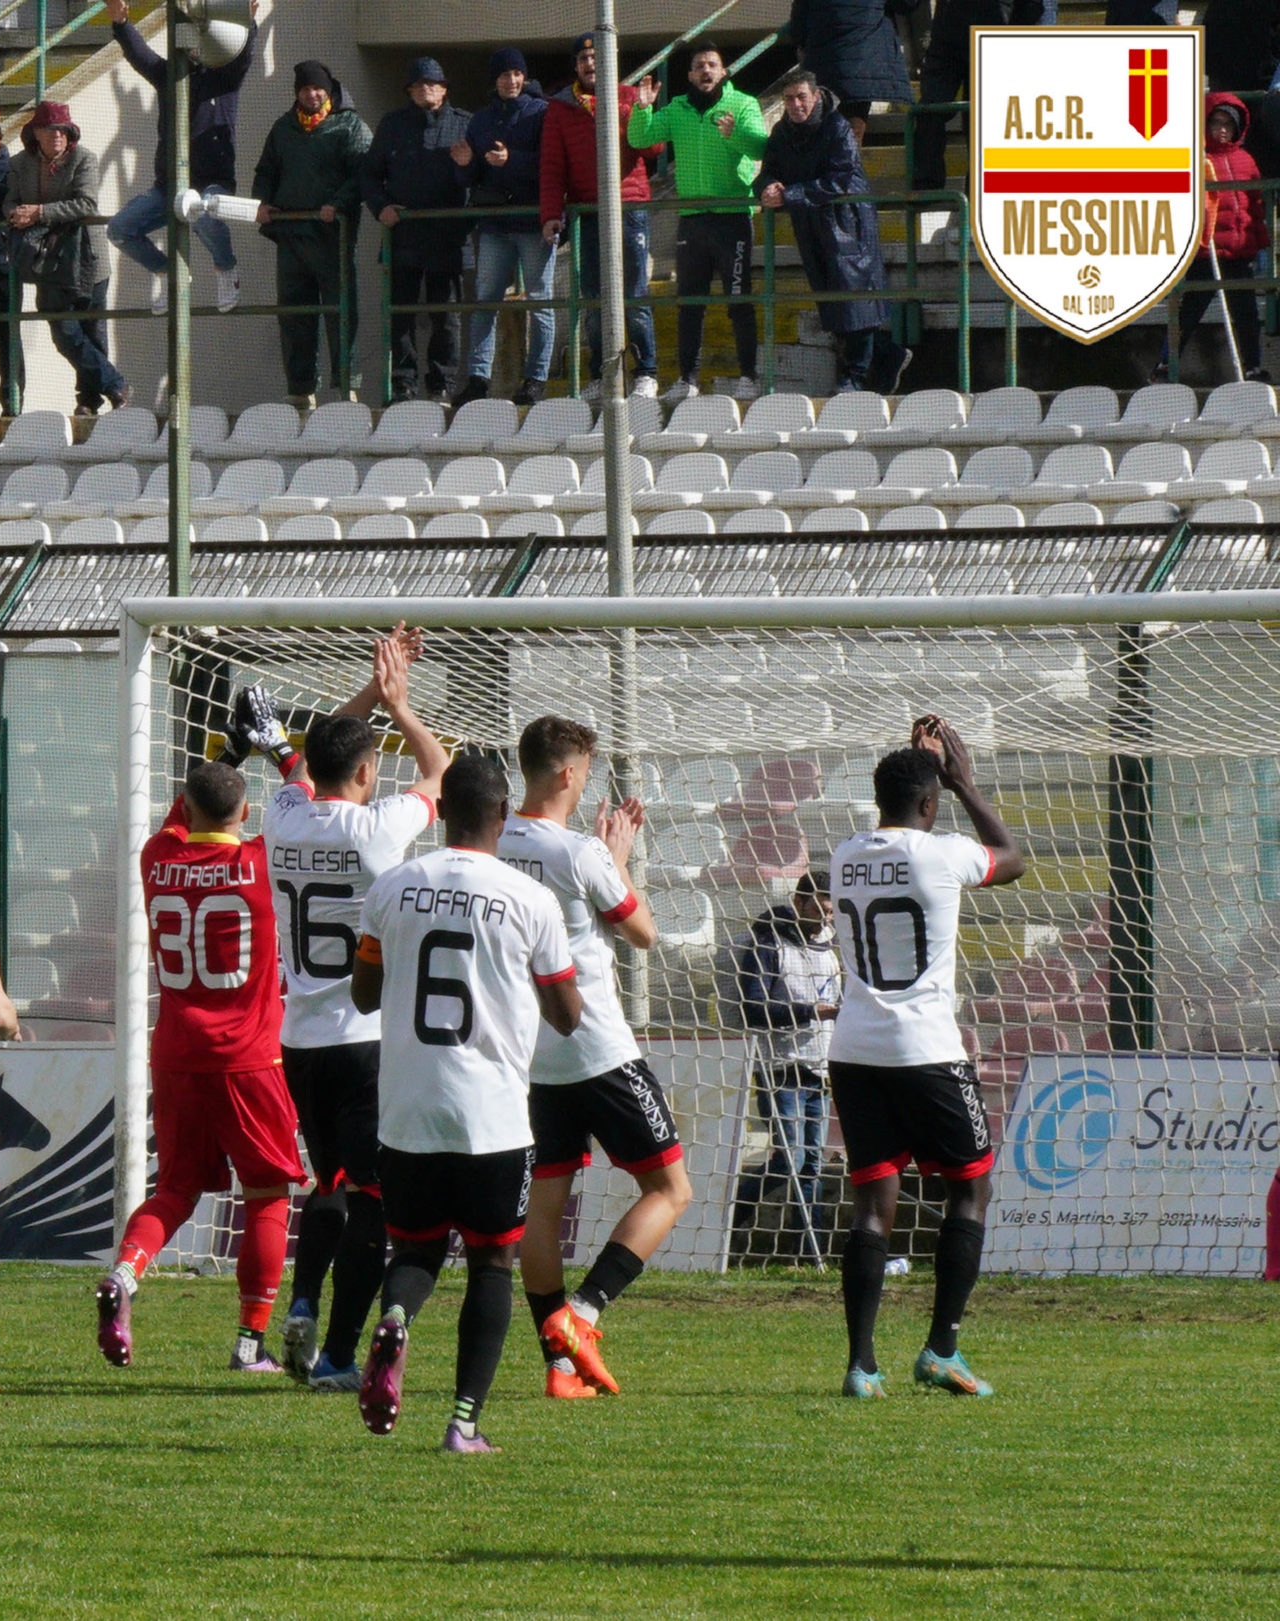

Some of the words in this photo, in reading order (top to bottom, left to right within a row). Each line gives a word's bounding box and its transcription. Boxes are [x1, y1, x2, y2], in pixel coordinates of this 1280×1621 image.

[148, 861, 256, 887] FUMAGALLI
[272, 846, 362, 873] CELESIA
[842, 862, 910, 887] BALDE
[277, 879, 358, 979] 16
[400, 887, 507, 926] FOFANA
[150, 894, 252, 990] 30
[838, 896, 929, 992] 10
[414, 929, 475, 1046] 6
